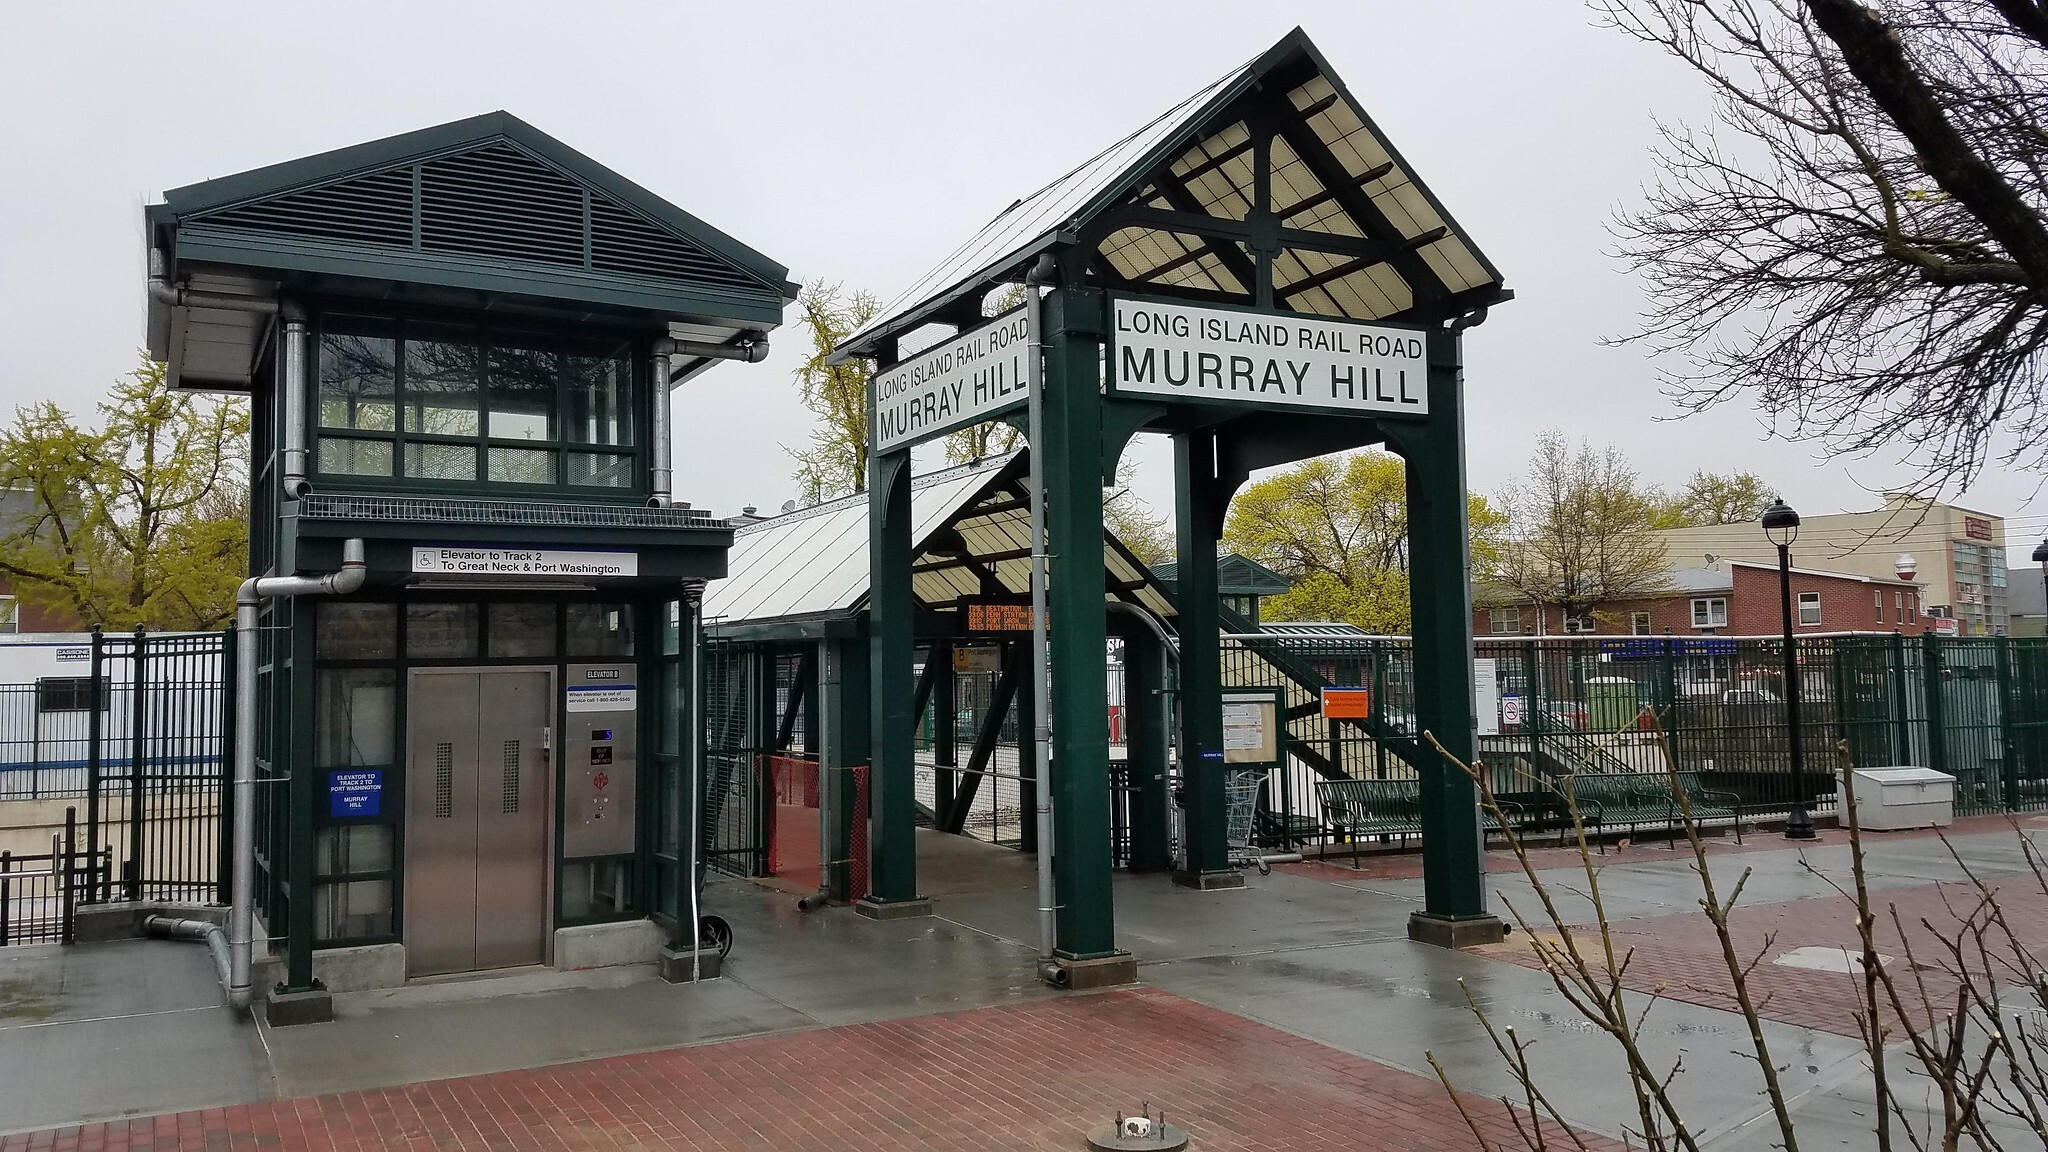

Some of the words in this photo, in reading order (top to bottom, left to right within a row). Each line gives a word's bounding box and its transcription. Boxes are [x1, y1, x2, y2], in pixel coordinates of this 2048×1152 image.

[1117, 309, 1190, 337] LONG
[1200, 317, 1289, 347] ISLAND
[1299, 327, 1351, 353] RAIL
[1359, 334, 1422, 359] ROAD
[878, 373, 907, 402] LONG
[910, 352, 952, 388] ISLAND
[956, 338, 985, 368] RAIL
[989, 317, 1029, 353] ROAD
[1122, 345, 1311, 396] MURRAY
[1330, 364, 1419, 404] HILL
[880, 378, 964, 442] MURRAY
[974, 355, 1026, 407] HILL
[440, 550, 486, 560] Elevator
[489, 552, 500, 560] to
[503, 551, 533, 561] Track
[535, 552, 542, 561] 2
[441, 561, 454, 570] To
[458, 561, 489, 571] Great
[492, 562, 520, 572] Neck
[523, 562, 531, 572] &
[535, 562, 557, 572] Port
[559, 563, 621, 575] Washington
[958, 648, 965, 661] B
